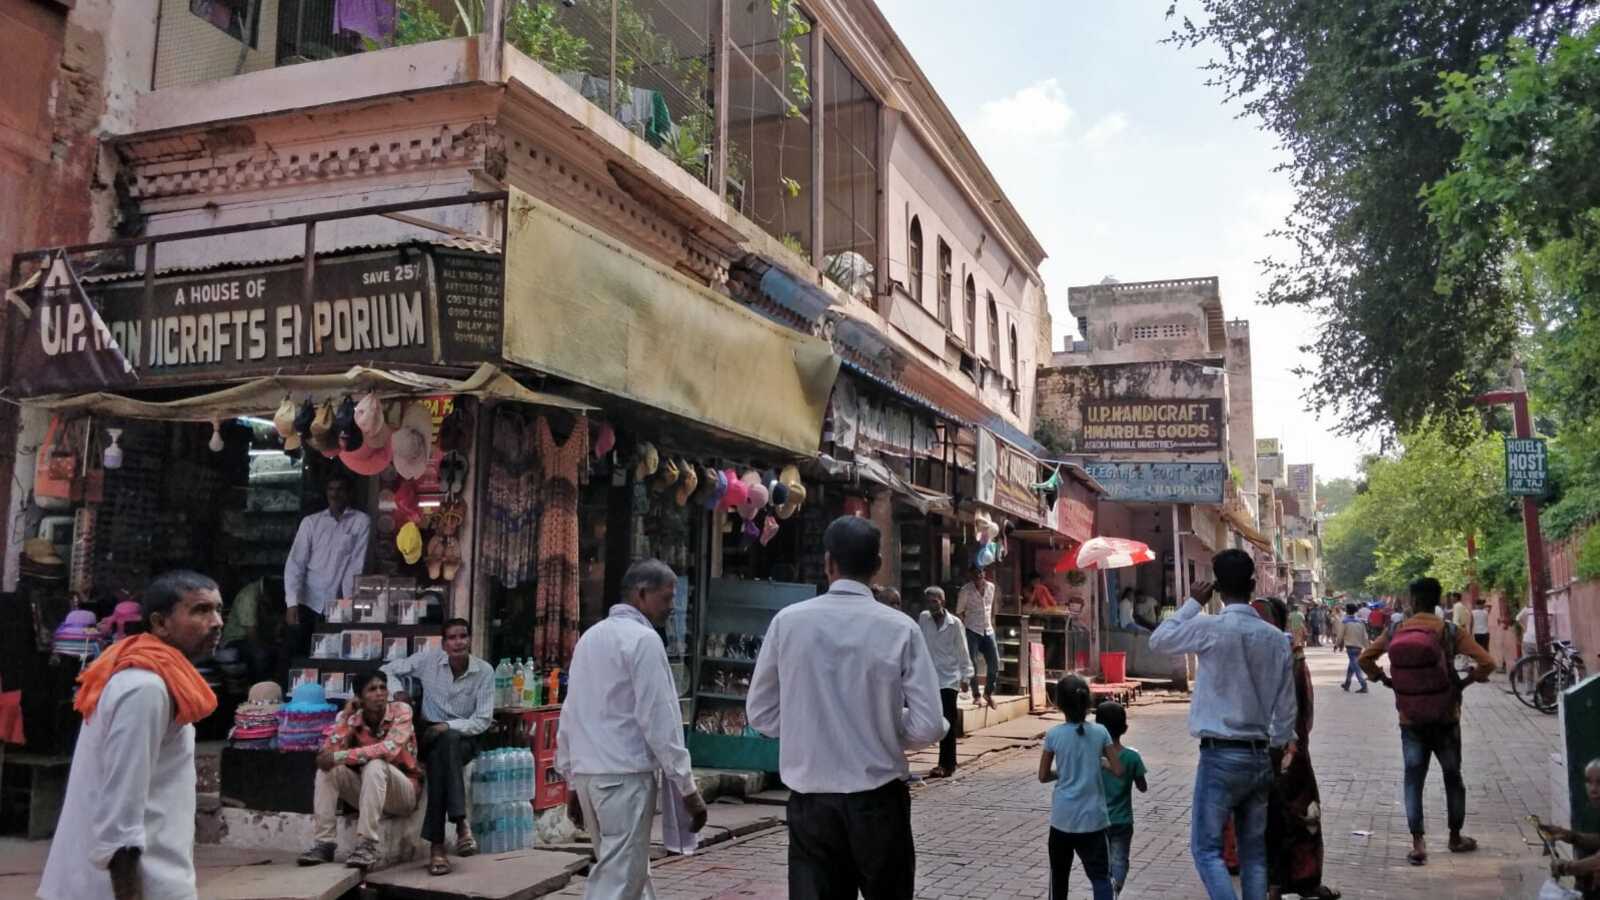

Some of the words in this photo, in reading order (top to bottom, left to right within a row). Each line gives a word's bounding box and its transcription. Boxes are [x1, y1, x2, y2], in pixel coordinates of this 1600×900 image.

[362, 271, 390, 285] SAVE
[174, 288, 186, 306] A
[191, 282, 240, 303] HOUSE
[246, 278, 267, 298] OF
[1157, 424, 1209, 438] GOODS
[1508, 440, 1537, 453] HOTEL
[1508, 453, 1546, 471] HOST
[1509, 470, 1527, 479] FULL
[1528, 470, 1546, 479] VIEW
[1527, 479, 1543, 487] TAJ
